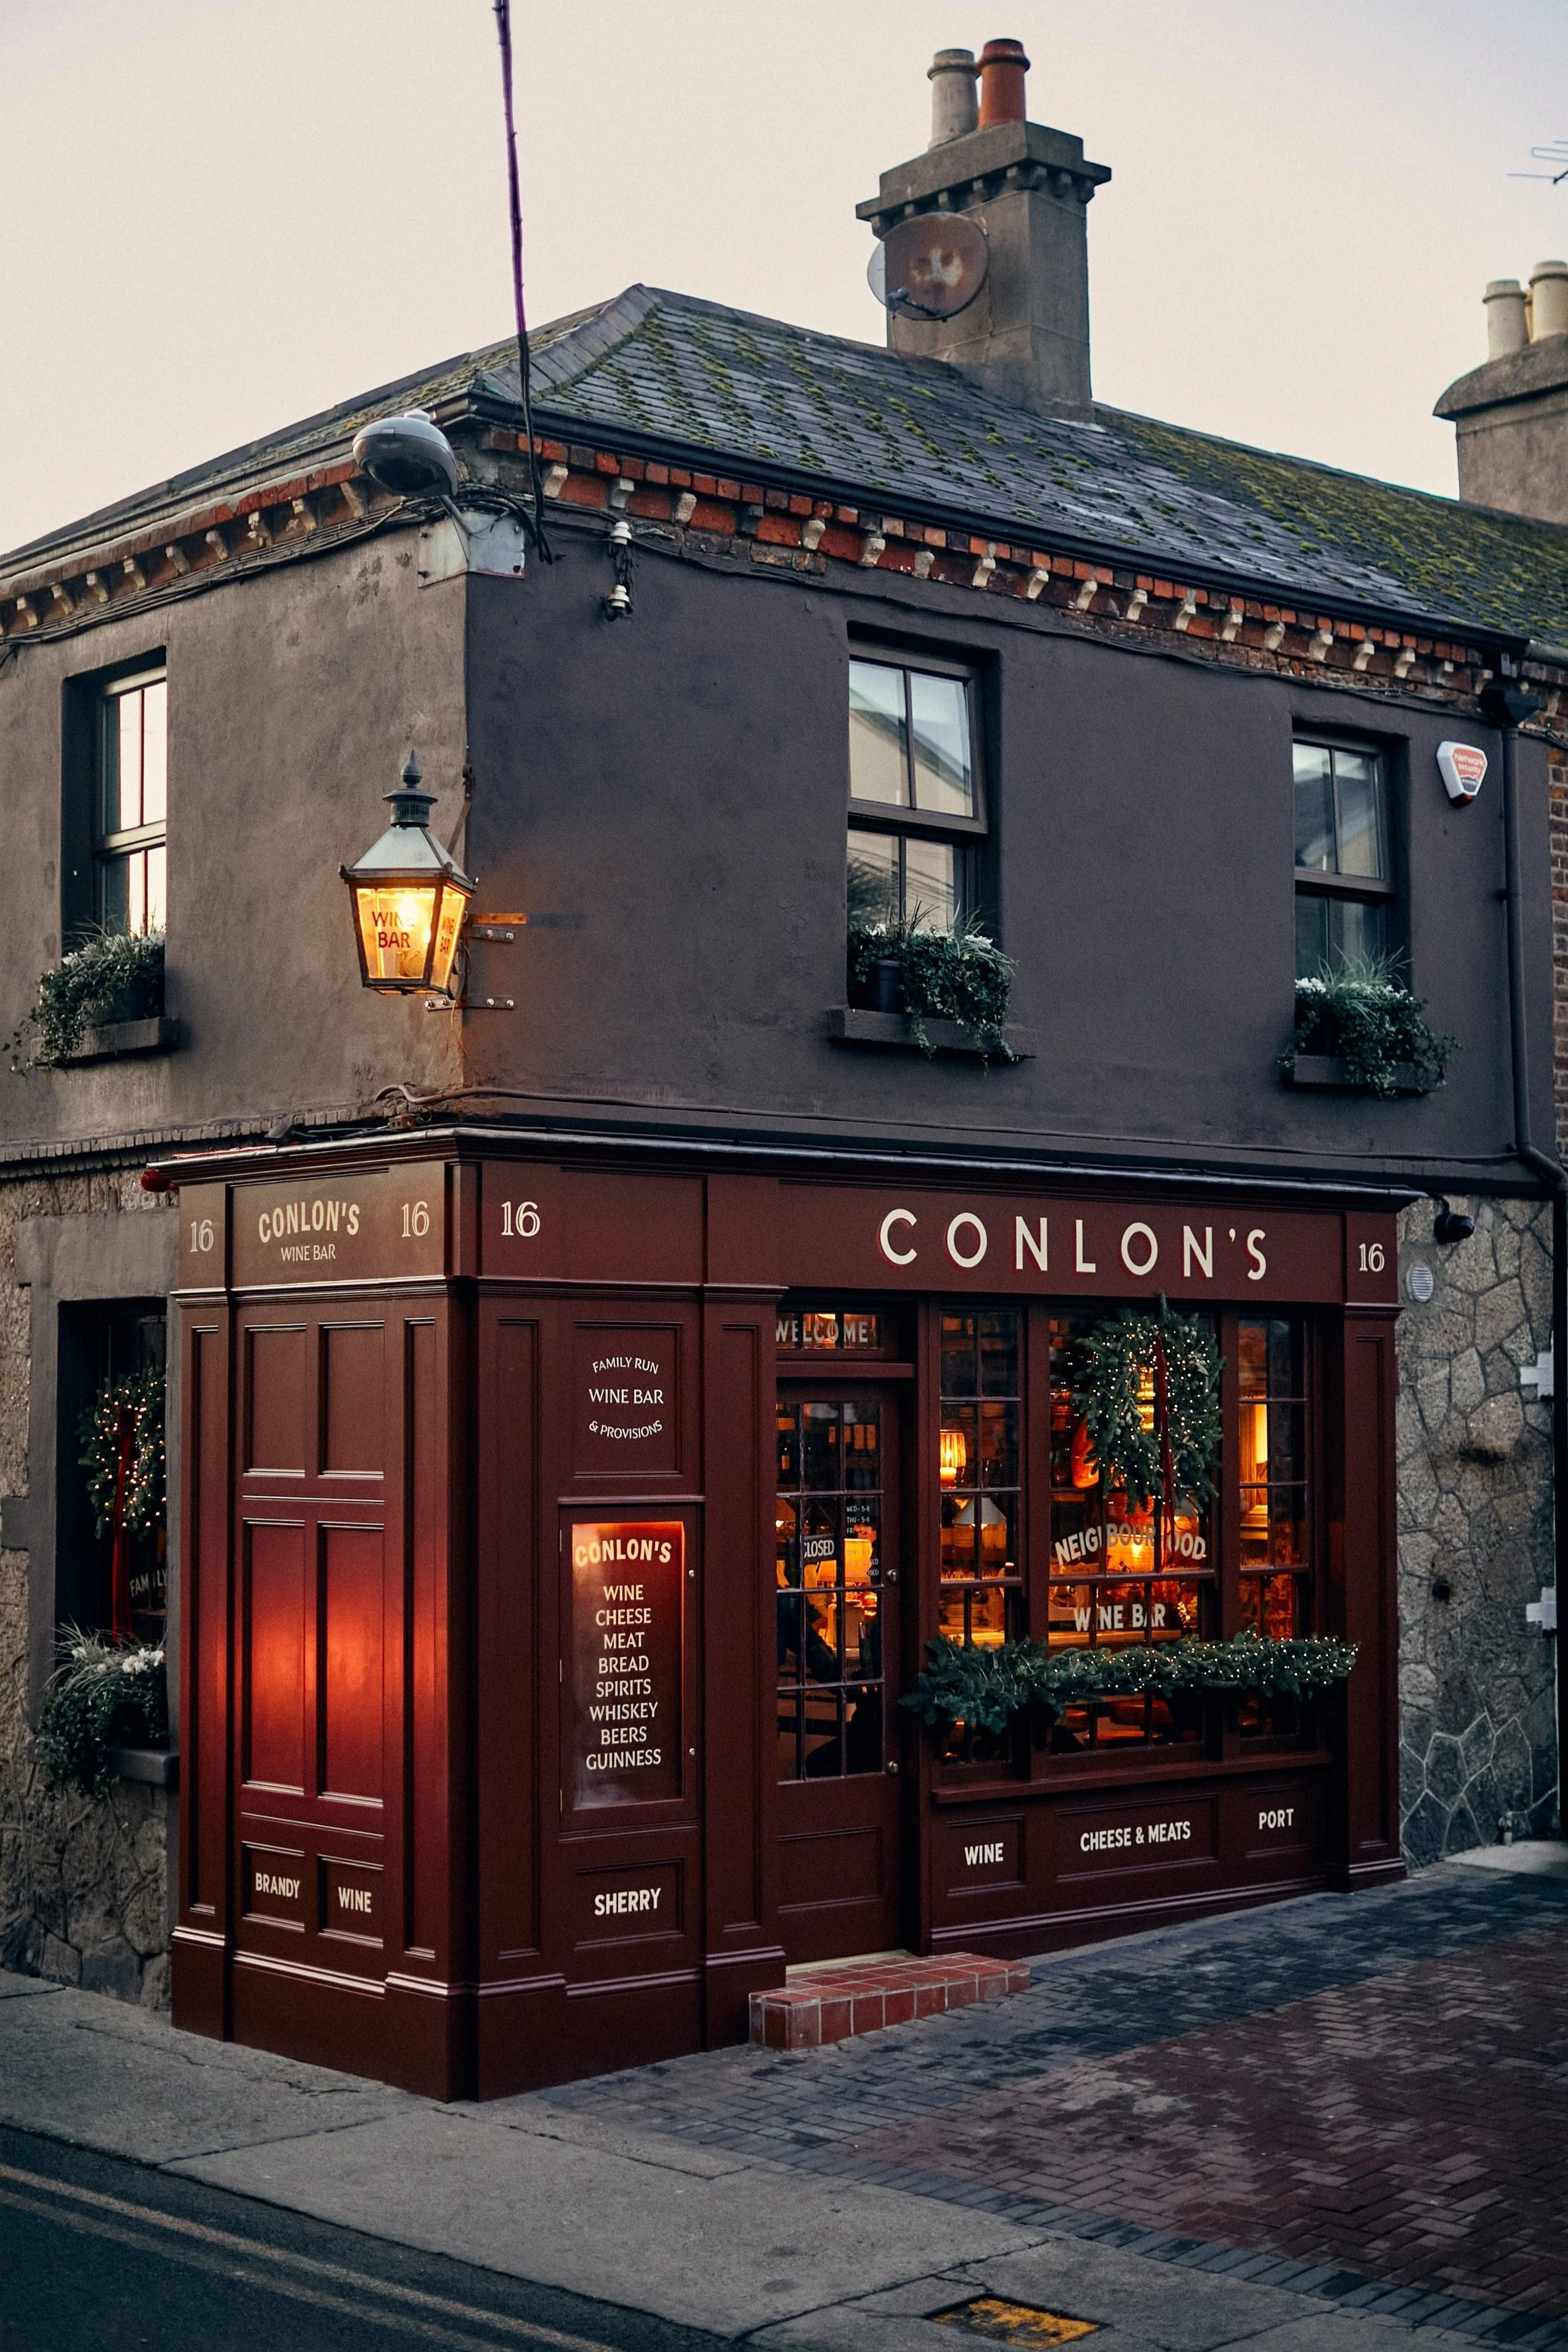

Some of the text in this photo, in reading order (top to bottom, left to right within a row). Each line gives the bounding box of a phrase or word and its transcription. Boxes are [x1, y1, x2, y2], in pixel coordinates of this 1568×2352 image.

[372, 911, 415, 927] WIN
[378, 931, 411, 948] BAR
[258, 1200, 360, 1243] CONLON'S
[401, 1200, 430, 1237] 16
[500, 1200, 541, 1237] 16
[190, 1219, 214, 1253] 16
[879, 1208, 1267, 1281] CONLON'S
[281, 1243, 336, 1262] WINE BAR
[1358, 1243, 1386, 1273] 16
[775, 1320, 869, 1343] WELCOME
[592, 1356, 659, 1375] FAMILY RUN
[588, 1388, 664, 1404] WINE BAR
[589, 1420, 663, 1439] & PROVISIONS
[574, 1538, 672, 1567] CONLON'S
[1054, 1522, 1206, 1566] NEIGBOUROOD
[130, 1569, 168, 1598] FAMILY
[603, 1585, 645, 1602] WINE
[596, 1608, 652, 1626] CHEESE
[1074, 1604, 1124, 1632] WNE
[604, 1631, 645, 1650] MEAT
[598, 1655, 649, 1674] BREAD
[596, 1678, 652, 1698] SPIRITS
[589, 1702, 658, 1722] WHISKEY
[600, 1726, 647, 1745] BEERS
[586, 1748, 662, 1770] GUINNESS
[1258, 1808, 1295, 1830] PORT
[1080, 1821, 1191, 1852] CHEESE & MEATS
[964, 1842, 1004, 1866] WINE
[255, 1872, 300, 1899] BRANDY
[338, 1886, 372, 1913] WINE
[594, 1887, 662, 1916] SHERRY
